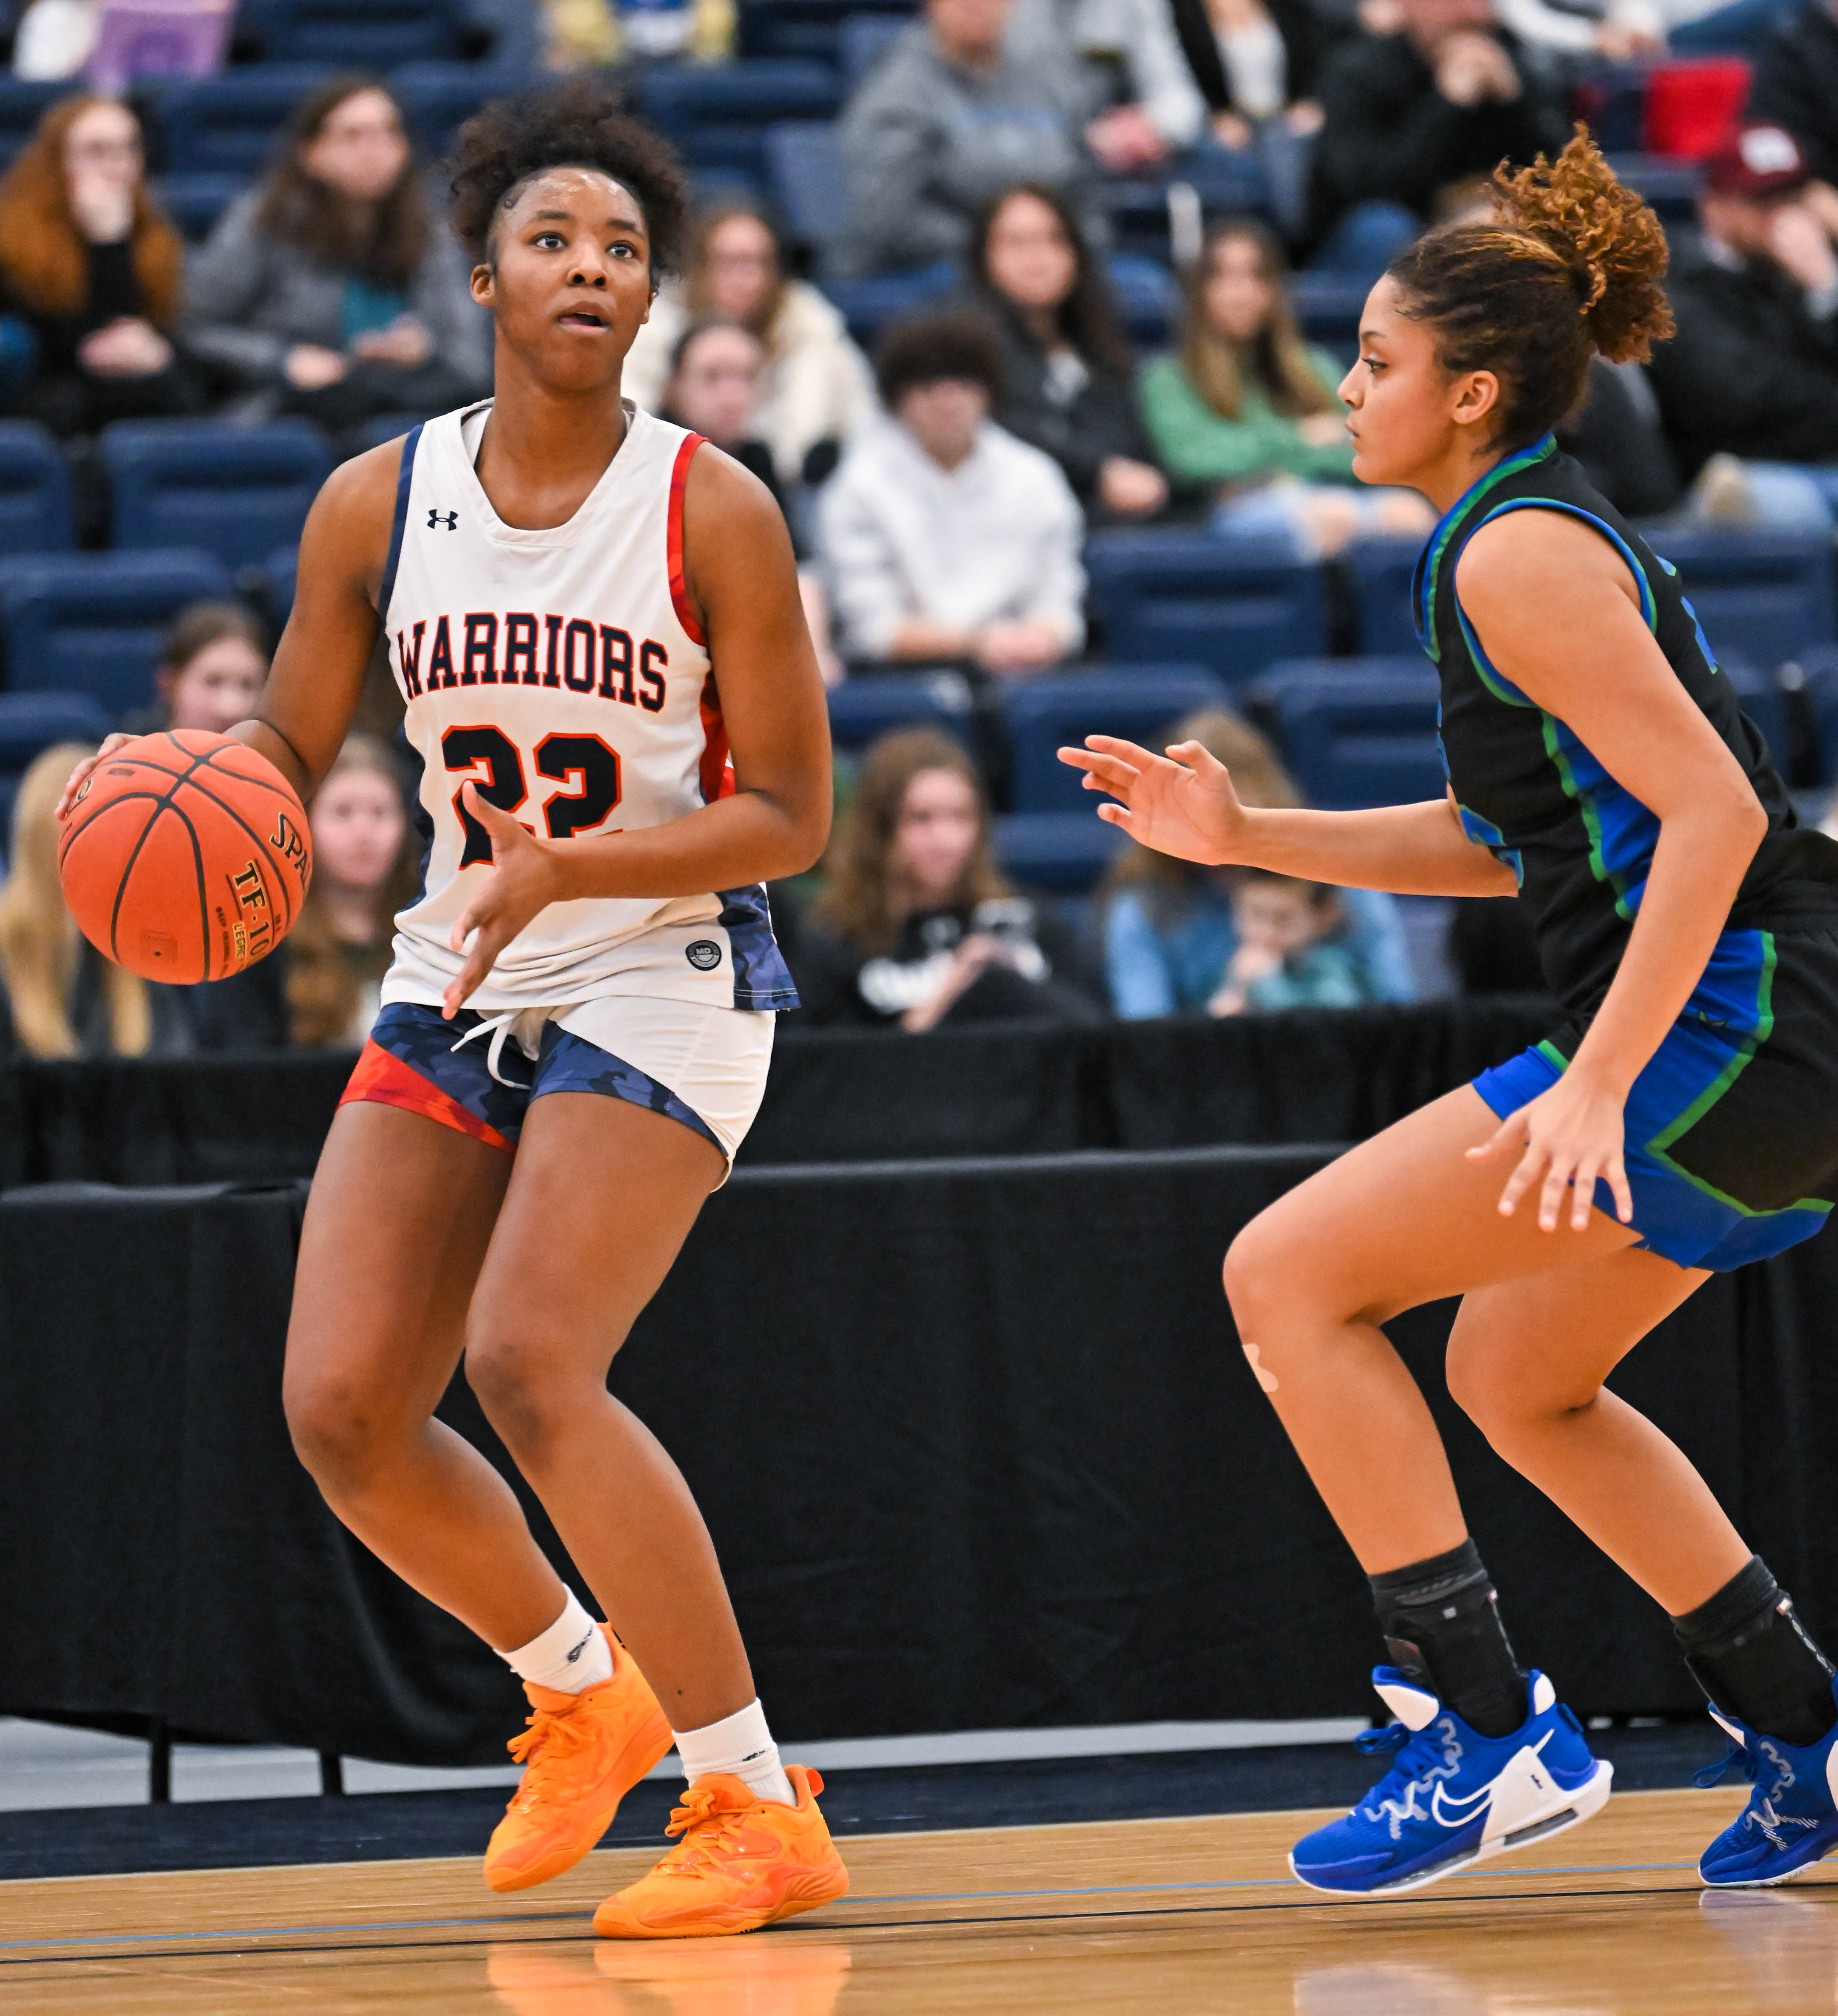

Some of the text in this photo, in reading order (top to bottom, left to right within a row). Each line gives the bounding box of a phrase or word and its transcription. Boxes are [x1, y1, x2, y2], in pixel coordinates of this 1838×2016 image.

[397, 612, 669, 713] WARRIORS
[441, 724, 623, 871] 22
[269, 811, 310, 890] SPA
